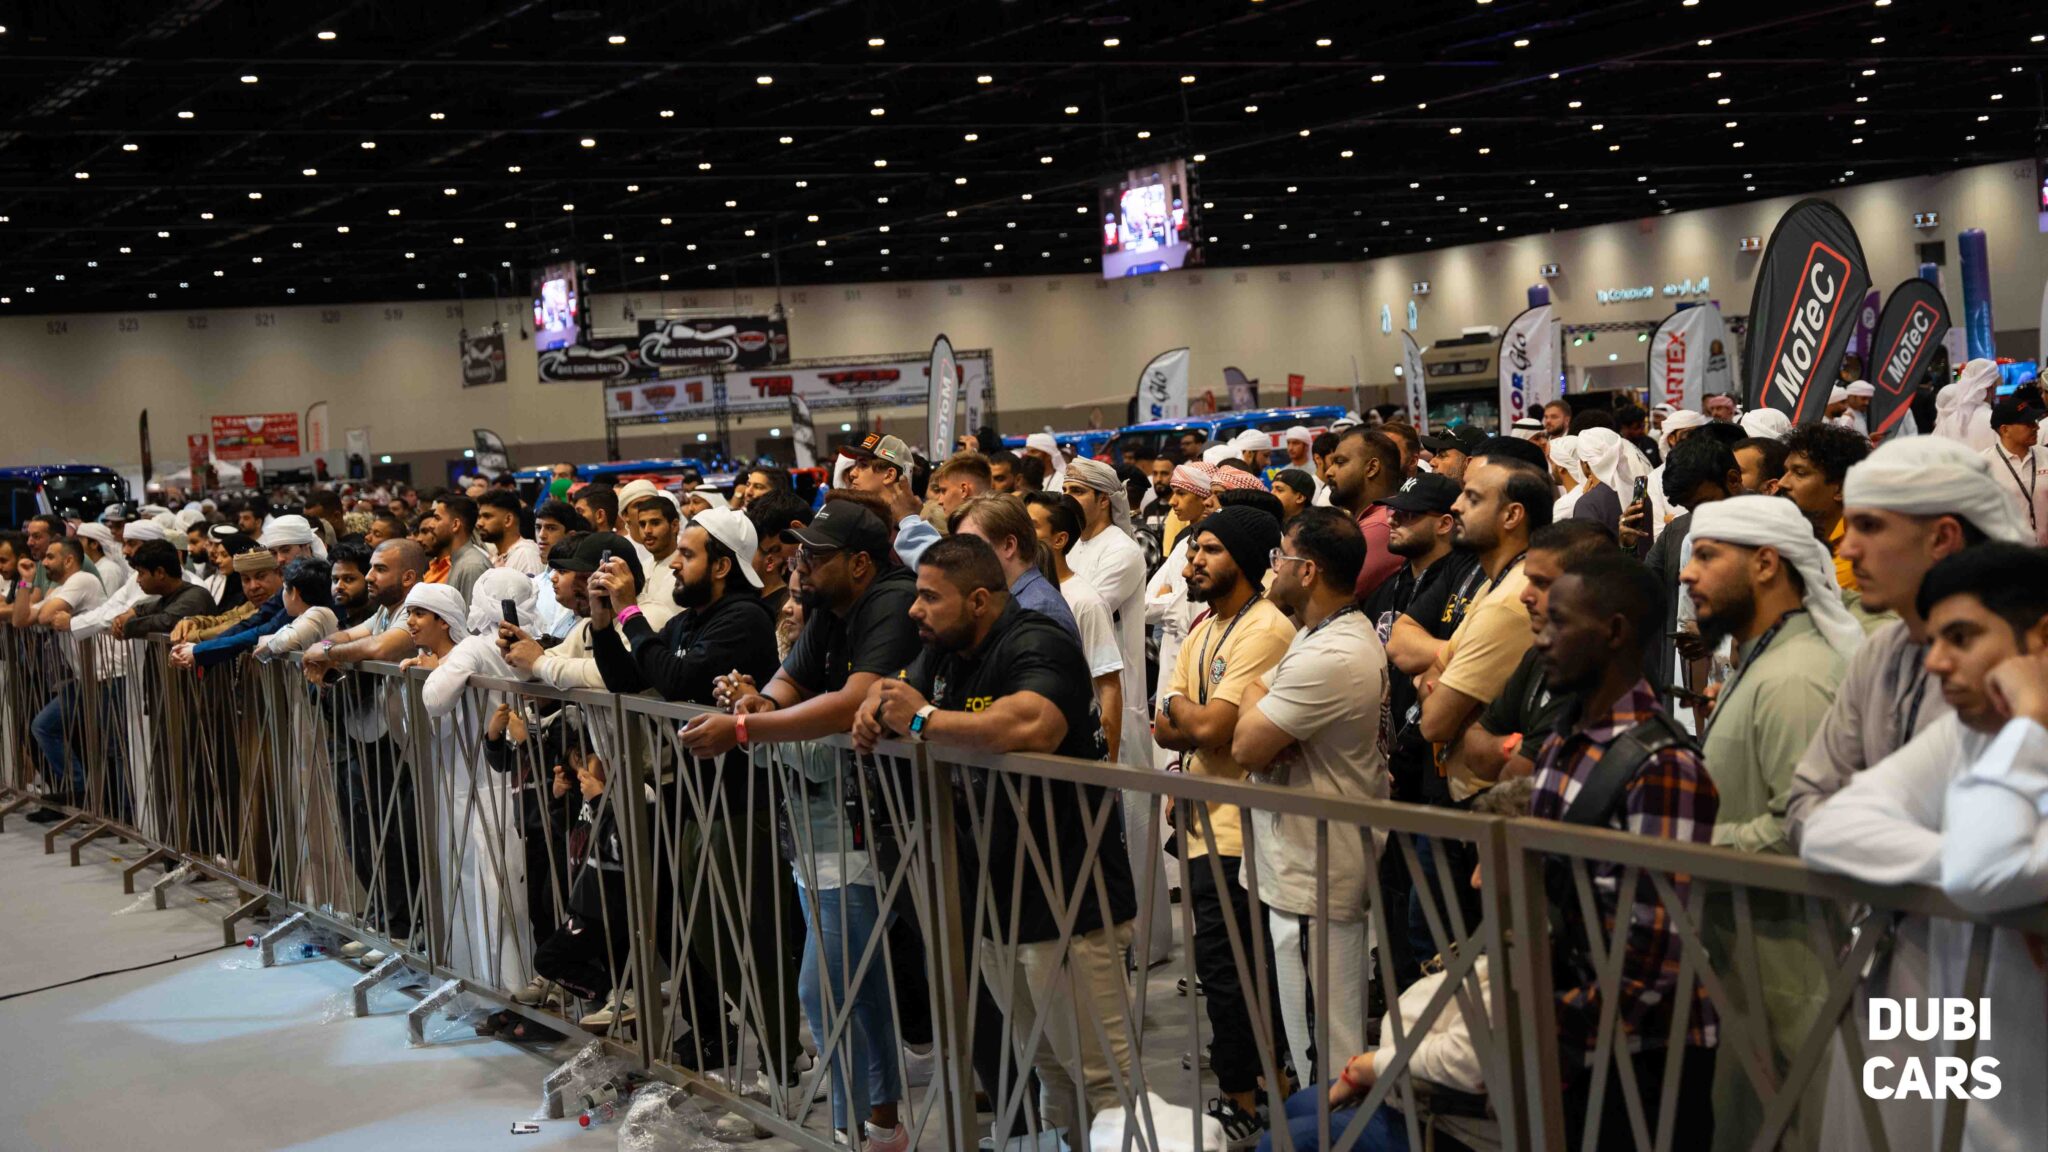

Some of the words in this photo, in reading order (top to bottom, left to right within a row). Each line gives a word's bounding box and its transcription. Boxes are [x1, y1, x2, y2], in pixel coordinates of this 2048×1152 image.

[46, 320, 68, 335] S24
[118, 317, 140, 333] S23
[1774, 262, 1835, 408] MoTeC
[1887, 310, 1929, 384] MoTeC
[1511, 372, 1524, 422] LOR
